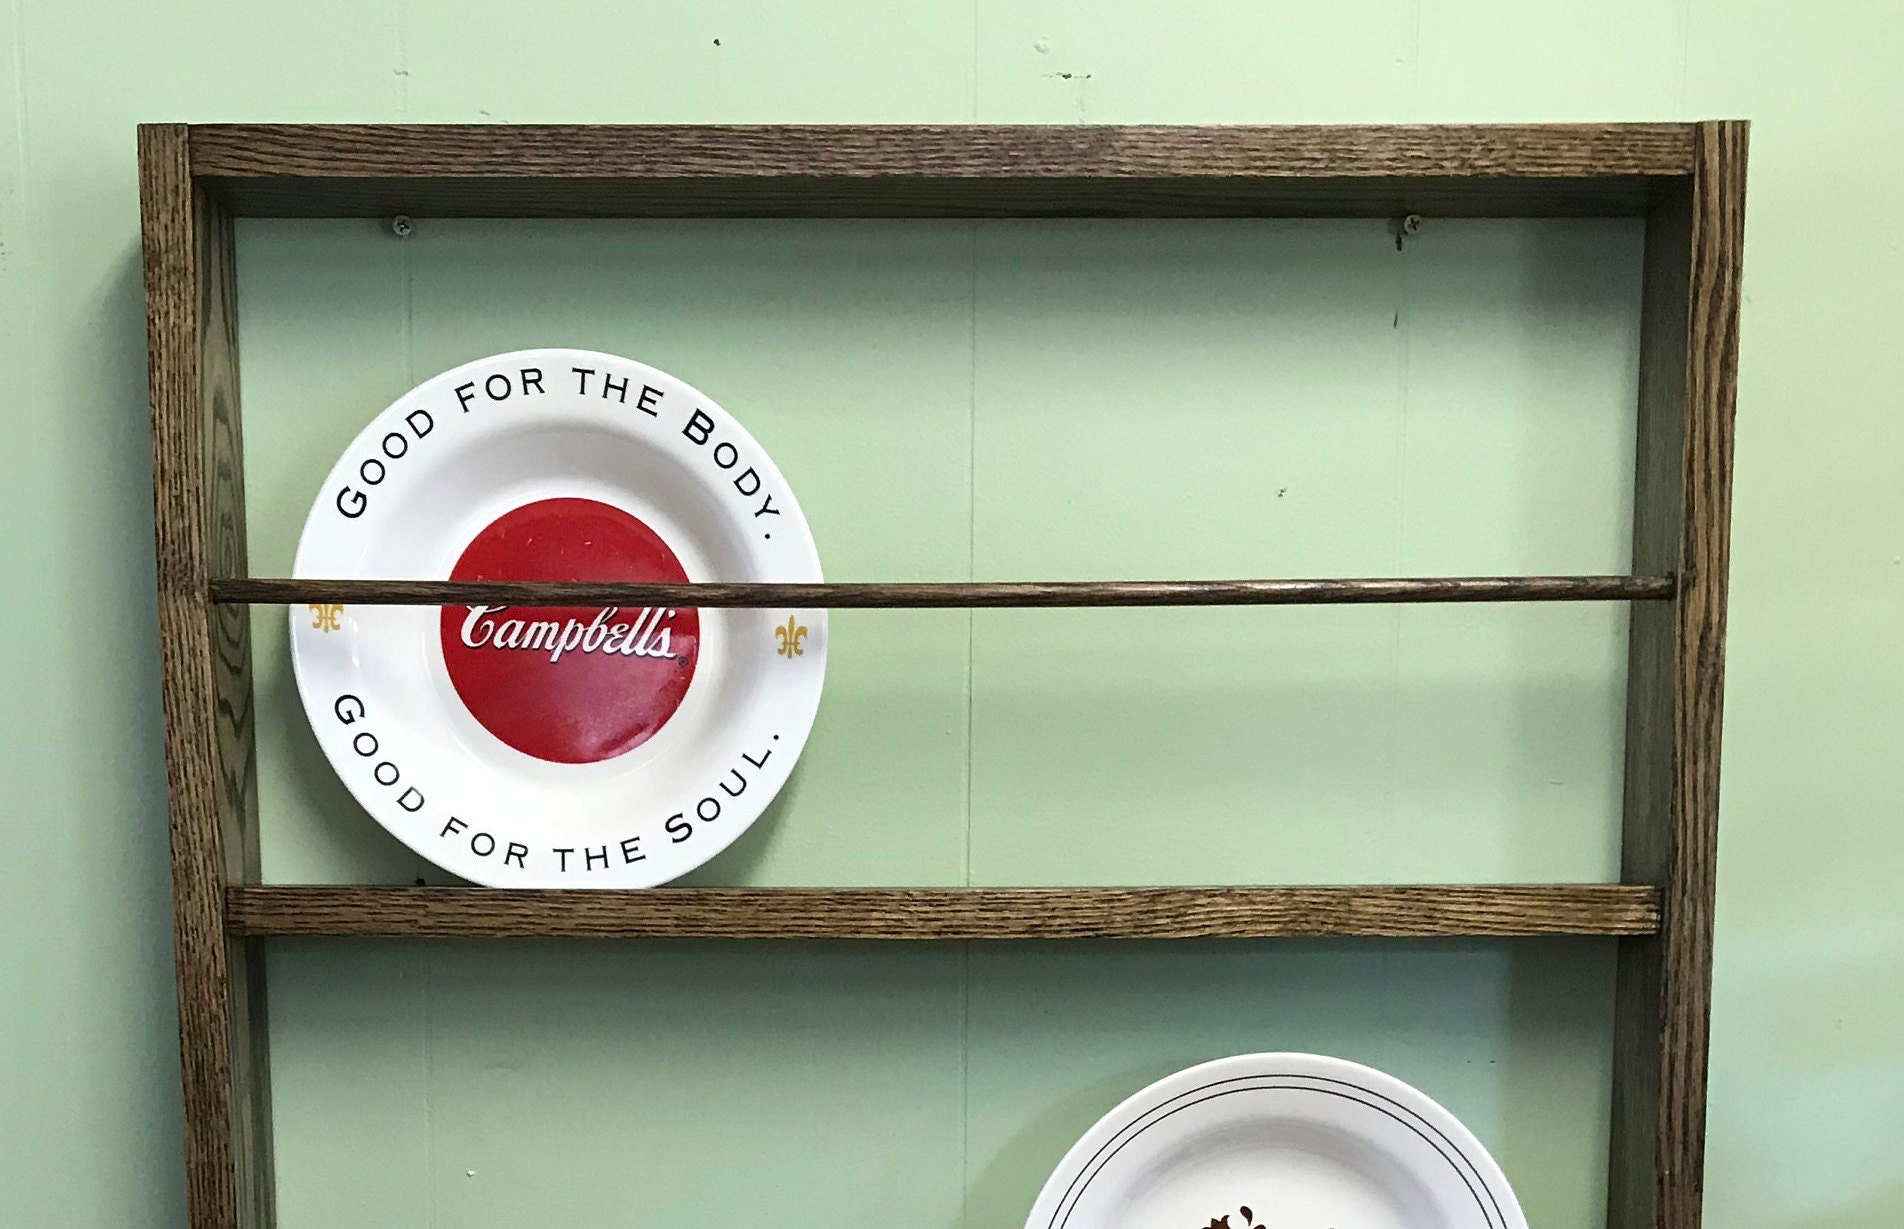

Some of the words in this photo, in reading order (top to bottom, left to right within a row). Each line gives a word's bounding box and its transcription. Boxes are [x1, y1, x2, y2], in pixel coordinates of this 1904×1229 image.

[336, 409, 434, 519] GOOD
[454, 367, 545, 413] FOR
[571, 367, 664, 418] THE
[681, 408, 781, 540] BODY.
[334, 694, 425, 813] GOOD
[440, 816, 529, 869] FOR
[552, 836, 646, 872] THE
[664, 734, 779, 844] SOUL.
